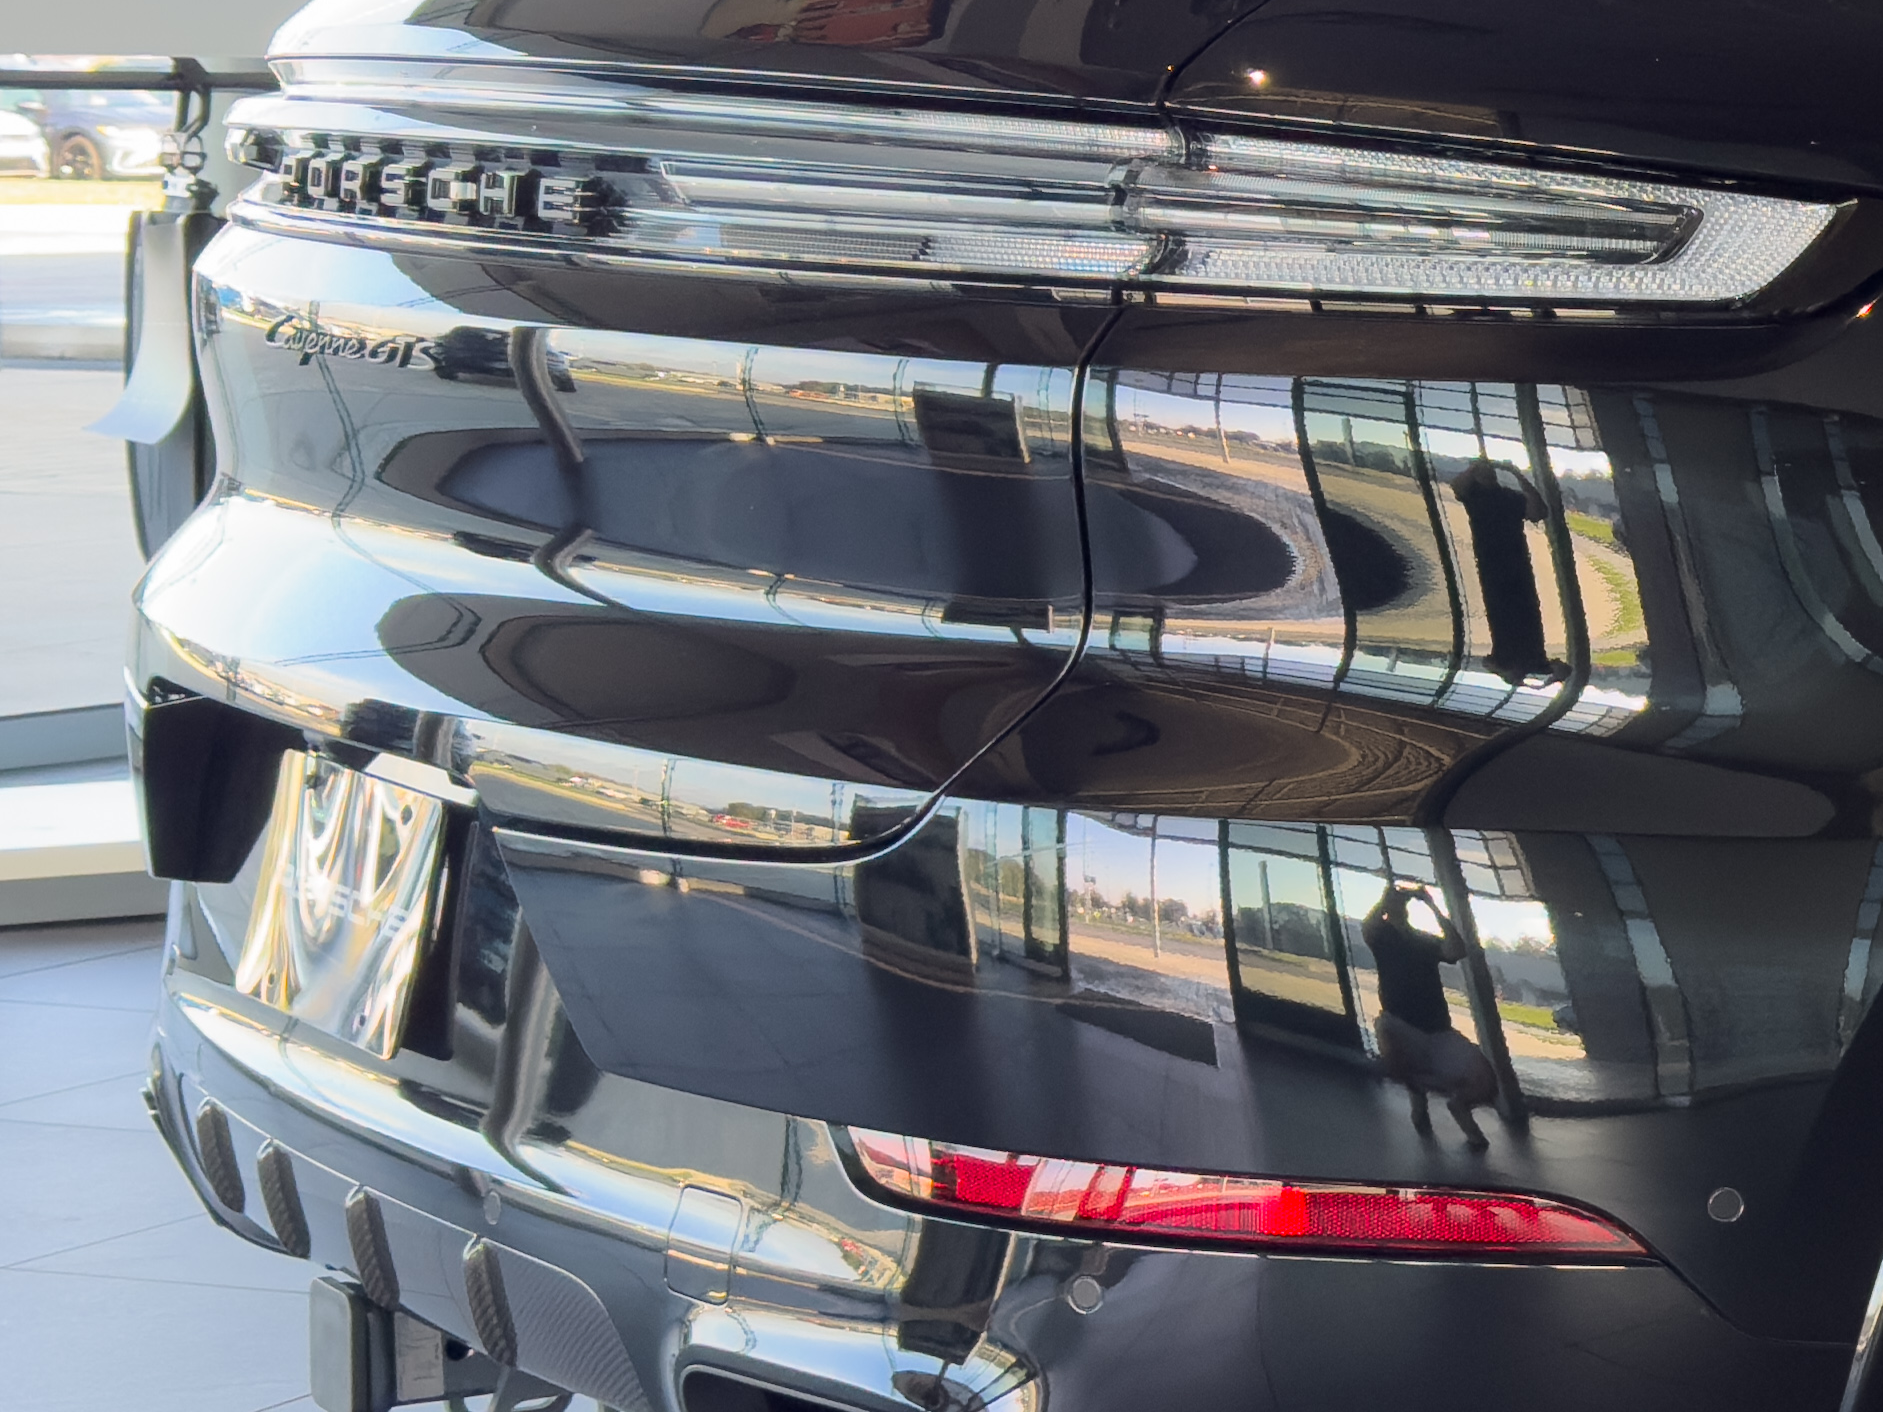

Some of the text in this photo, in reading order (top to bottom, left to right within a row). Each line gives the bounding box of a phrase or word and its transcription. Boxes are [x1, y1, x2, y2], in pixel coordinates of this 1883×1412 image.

[280, 152, 582, 225] PORSCHE
[265, 314, 438, 370] Cayenne GTS
[279, 860, 410, 938] PSCHE
